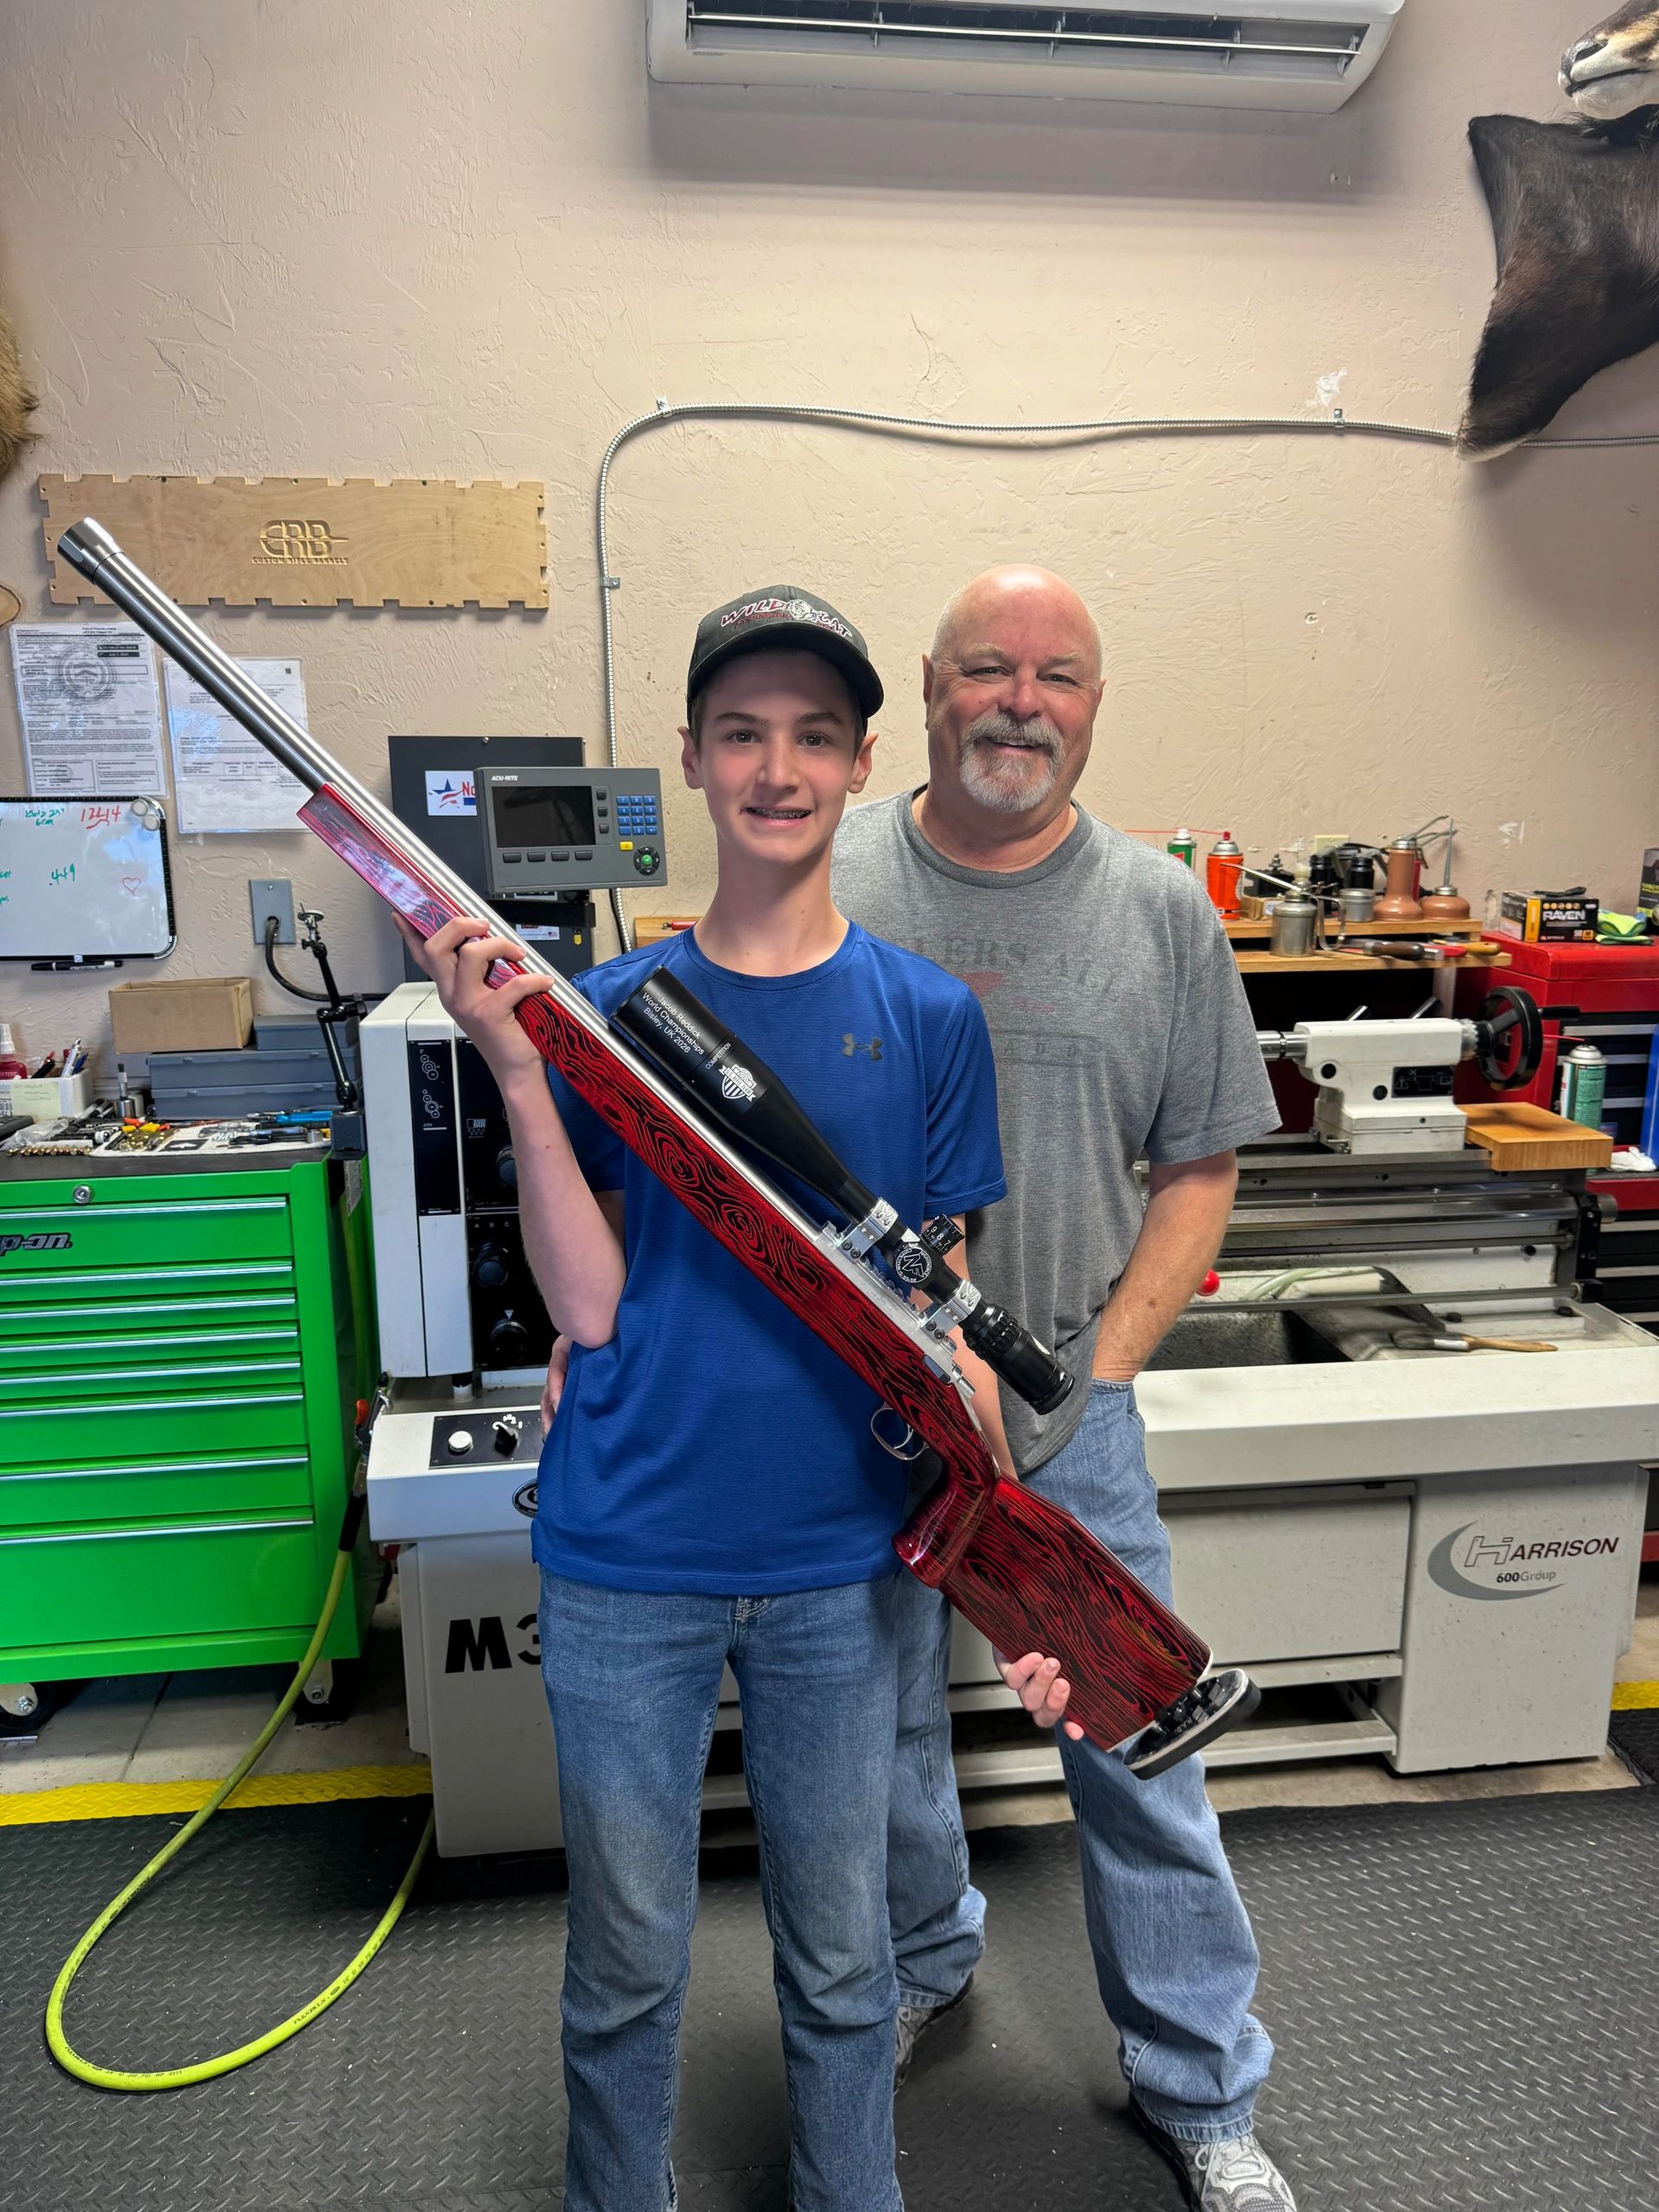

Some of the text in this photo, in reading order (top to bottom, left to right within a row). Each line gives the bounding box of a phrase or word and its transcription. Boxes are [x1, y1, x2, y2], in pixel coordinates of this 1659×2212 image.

[1542, 909, 1586, 921] RAVEN
[642, 992, 705, 1056] World Championships
[643, 1007, 691, 1053] Bisley, UK 2026
[658, 995, 702, 1039] Jacob Reddick
[705, 1042, 732, 1070] COMPETITION
[1464, 1535, 1620, 1567] HARRISON
